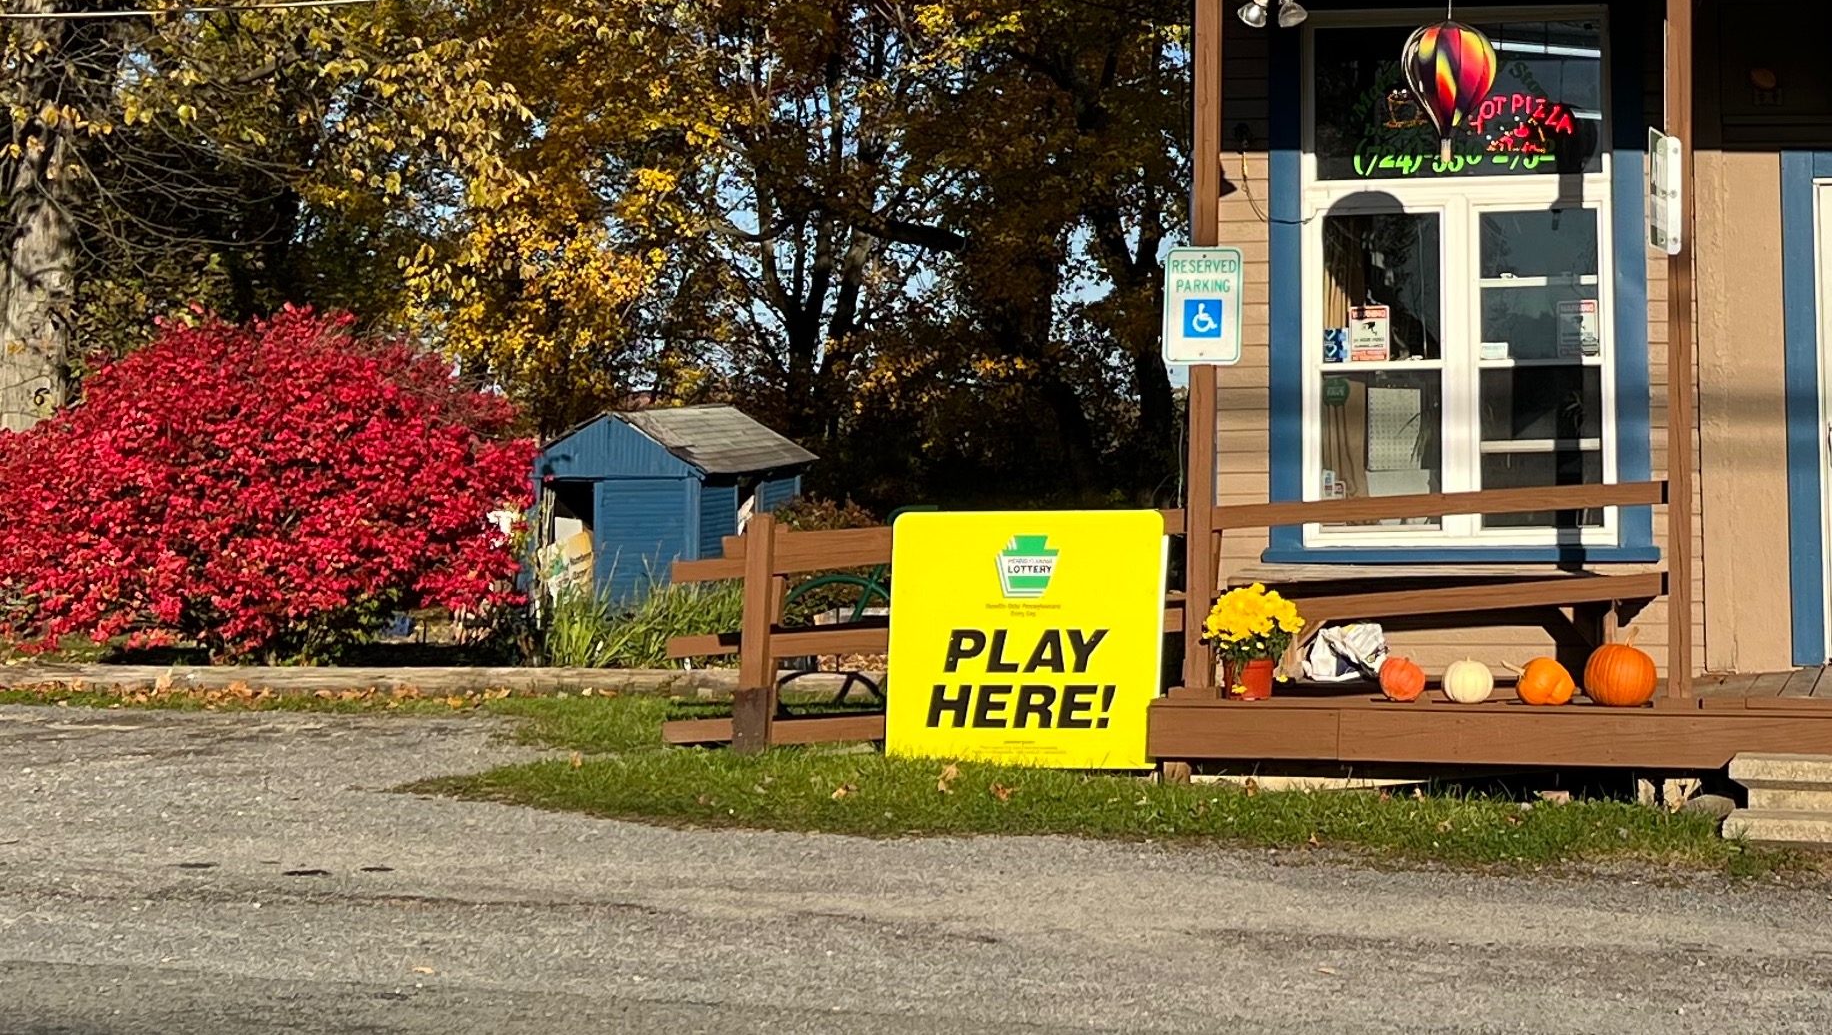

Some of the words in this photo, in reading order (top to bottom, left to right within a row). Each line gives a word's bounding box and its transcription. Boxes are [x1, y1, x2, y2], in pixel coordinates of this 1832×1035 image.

[1510, 92, 1577, 136] PIZZA
[1172, 259, 1237, 273] RESERVED
[1176, 279, 1231, 293] PARKING
[1007, 565, 1052, 574] LOTTERY
[943, 628, 1110, 673] PLAY
[925, 684, 1117, 728] HERE!
